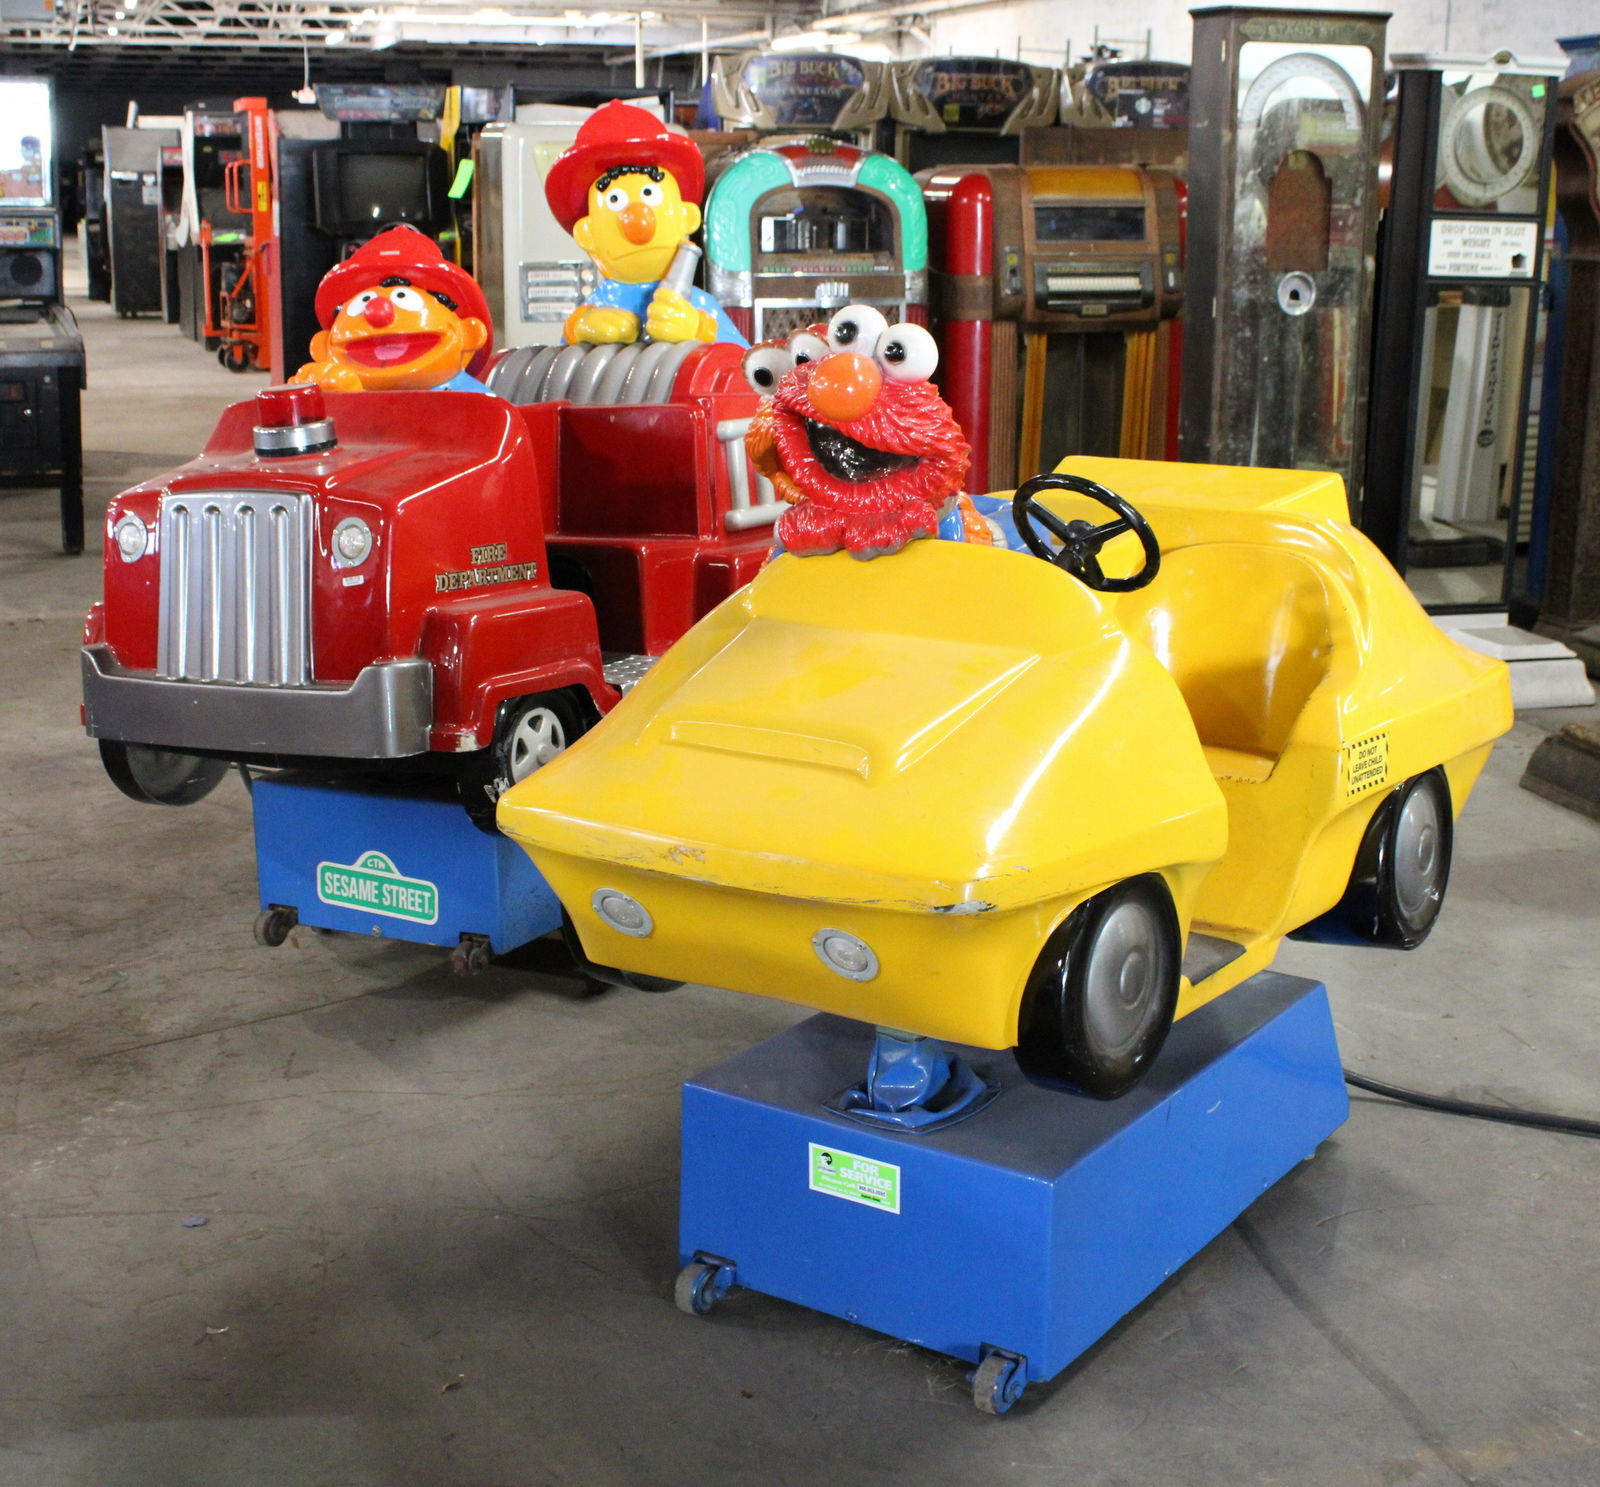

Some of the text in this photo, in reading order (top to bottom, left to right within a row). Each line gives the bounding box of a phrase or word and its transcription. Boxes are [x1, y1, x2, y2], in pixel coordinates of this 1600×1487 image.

[768, 60, 840, 79] BIG BUCK
[933, 72, 1018, 97] BIG BUCK
[1440, 224, 1527, 237] DROP COIN IN SLOT
[1461, 238, 1492, 248] WEIGHT
[470, 542, 507, 565] FIRE
[435, 561, 537, 593] DEPARTMENT
[1358, 745, 1378, 760] DO NOT
[1353, 755, 1383, 773] LEAVE CHILD
[1351, 765, 1384, 785] UNATTENDED
[366, 858, 387, 870] CTW
[324, 871, 432, 914] SESAME STREET
[852, 1159, 879, 1176] FOR
[839, 1167, 893, 1190] SERVICE
